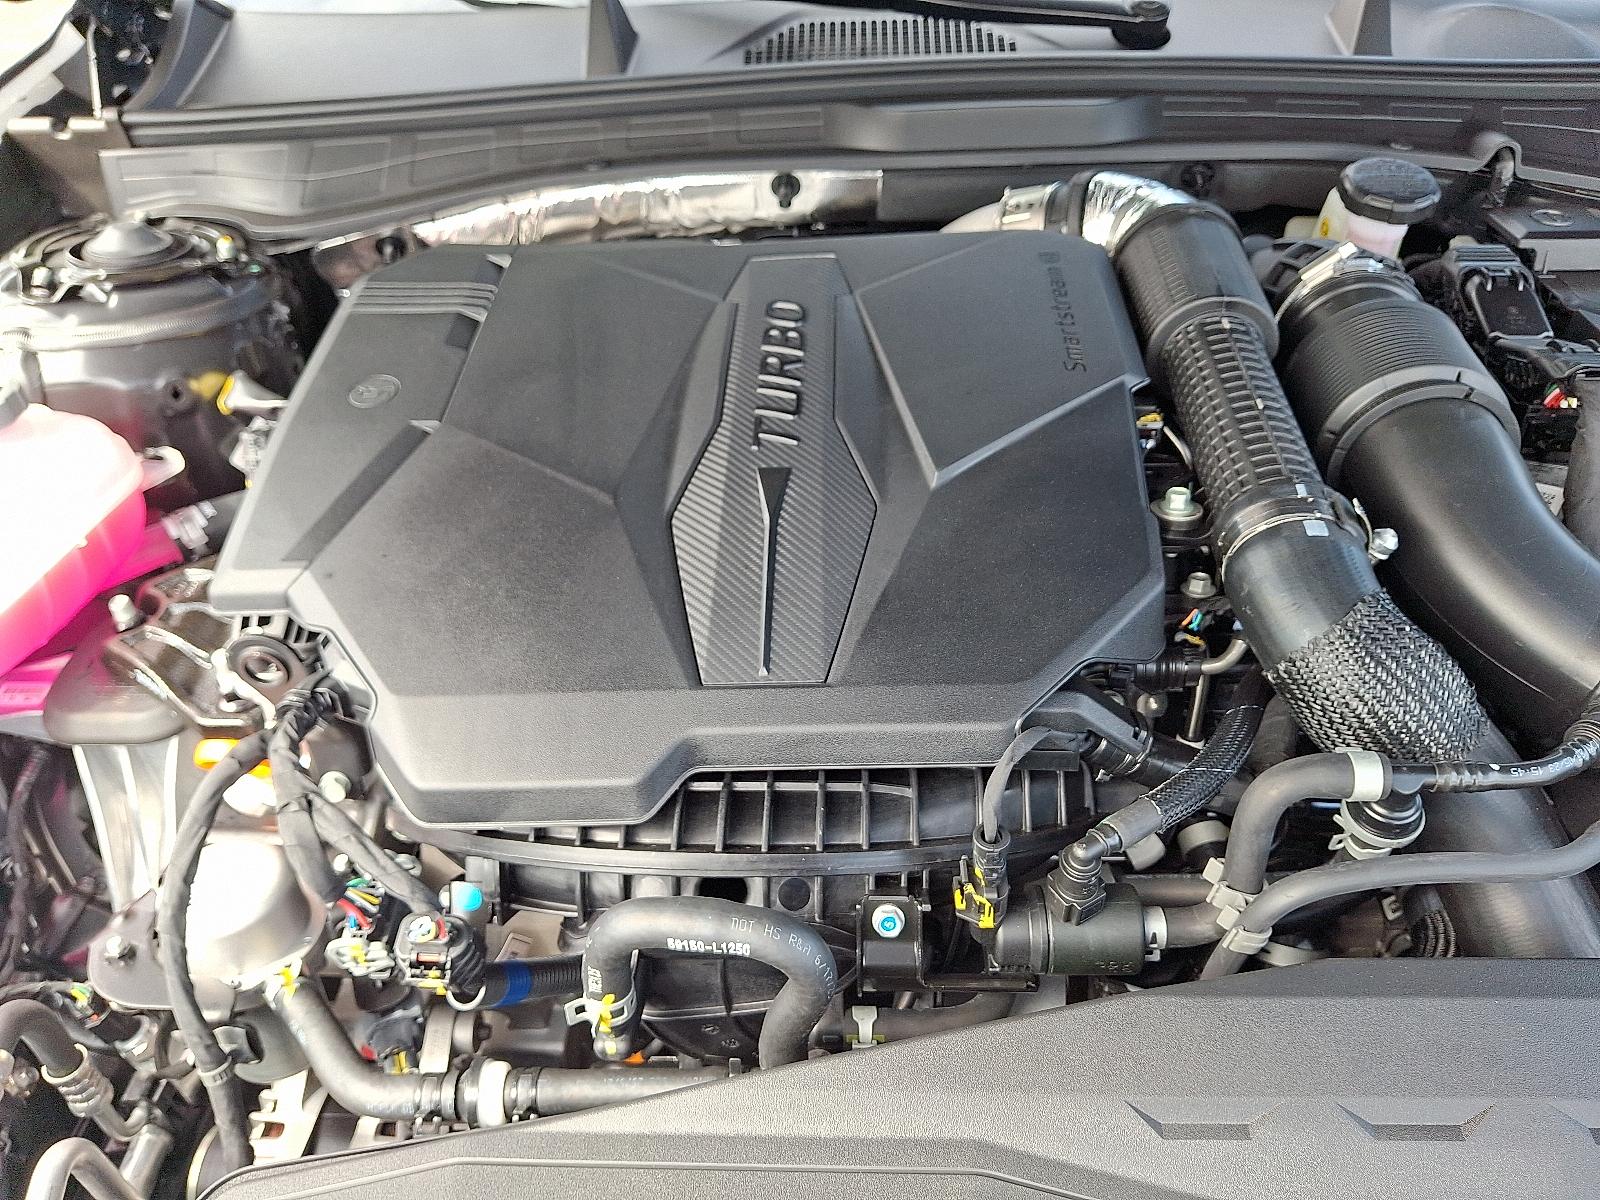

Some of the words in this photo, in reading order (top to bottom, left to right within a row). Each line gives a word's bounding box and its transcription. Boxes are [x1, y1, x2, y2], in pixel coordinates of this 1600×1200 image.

[1047, 267, 1087, 373] Smartstream
[751, 300, 805, 451] TURBO
[763, 923, 782, 940] HS
